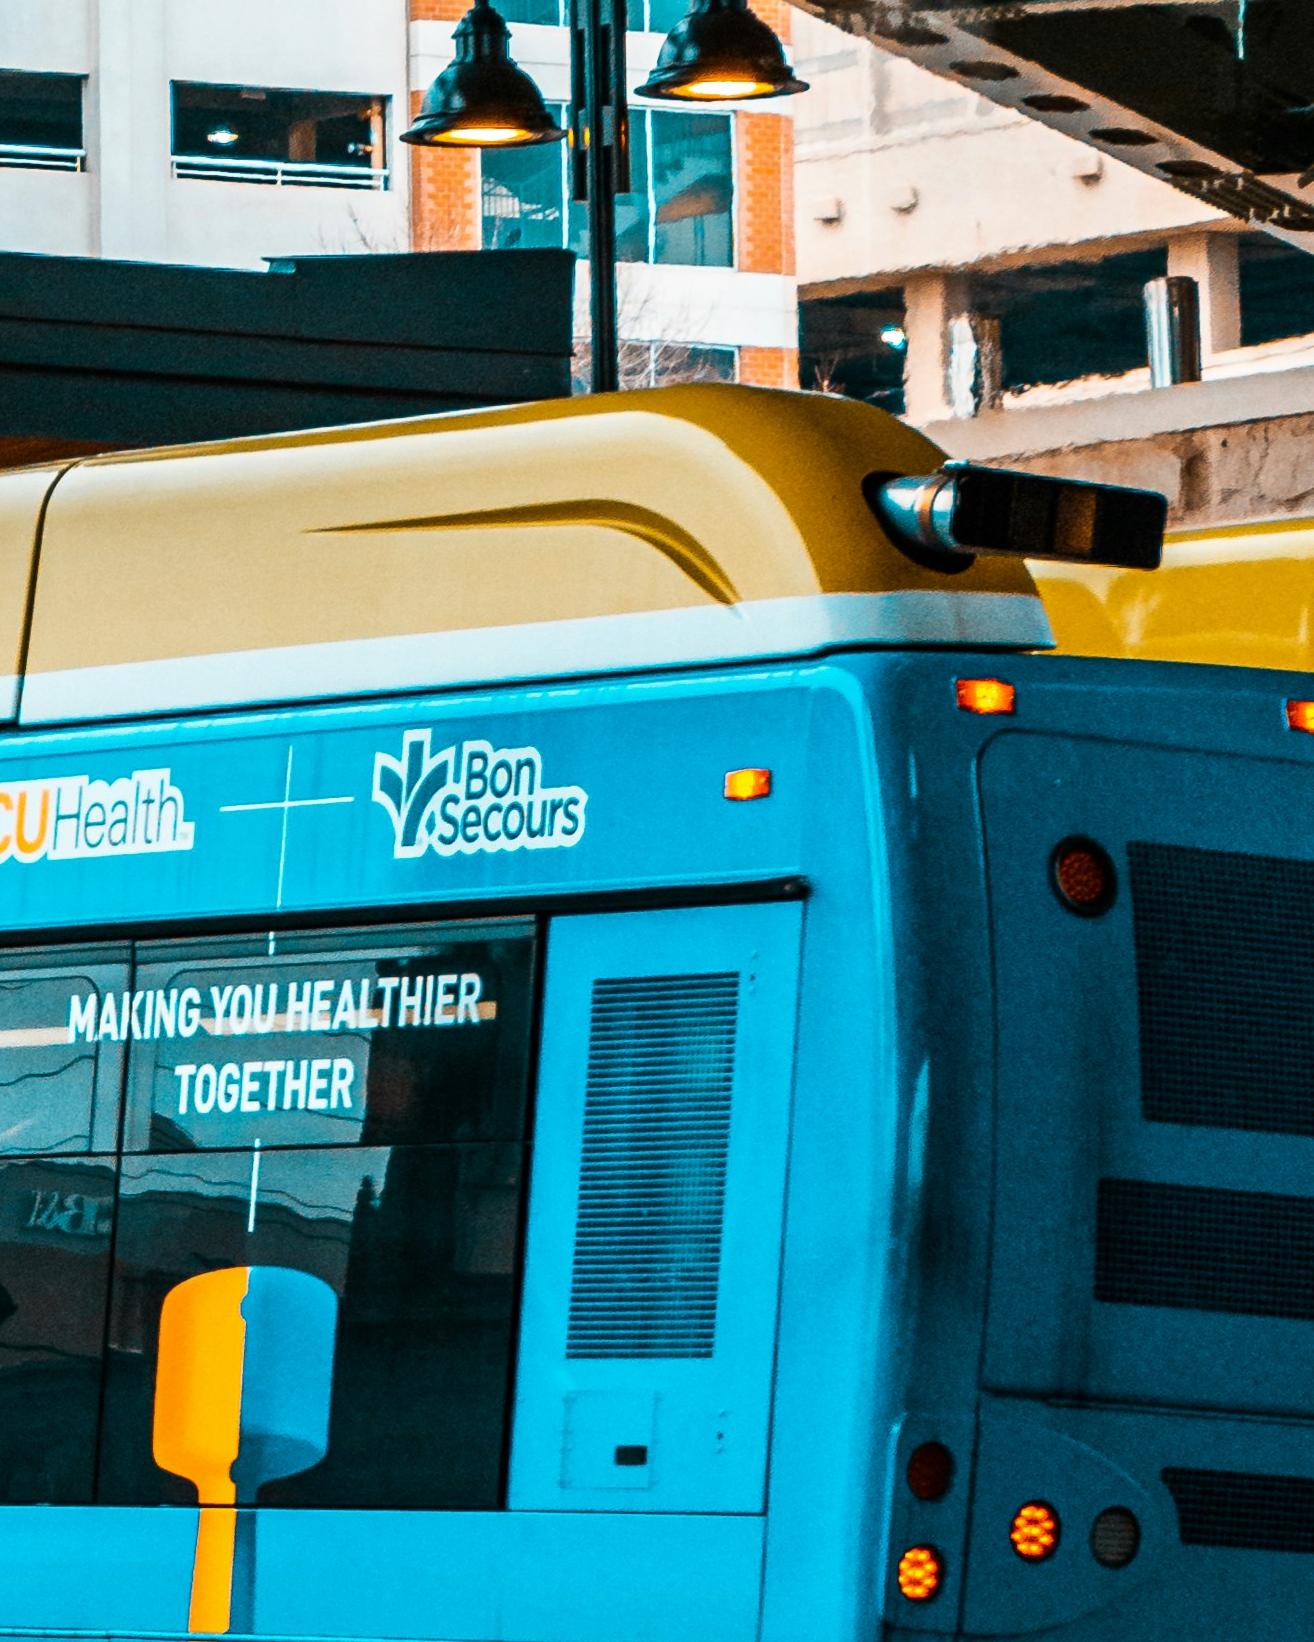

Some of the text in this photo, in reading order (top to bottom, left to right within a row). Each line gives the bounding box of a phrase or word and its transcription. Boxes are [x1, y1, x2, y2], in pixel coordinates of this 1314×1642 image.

[465, 750, 535, 801] Bon
[437, 793, 580, 845] Secours
[68, 972, 483, 1044] MAKING YOU HEALTHIER
[173, 1058, 356, 1115] TOGETHER
